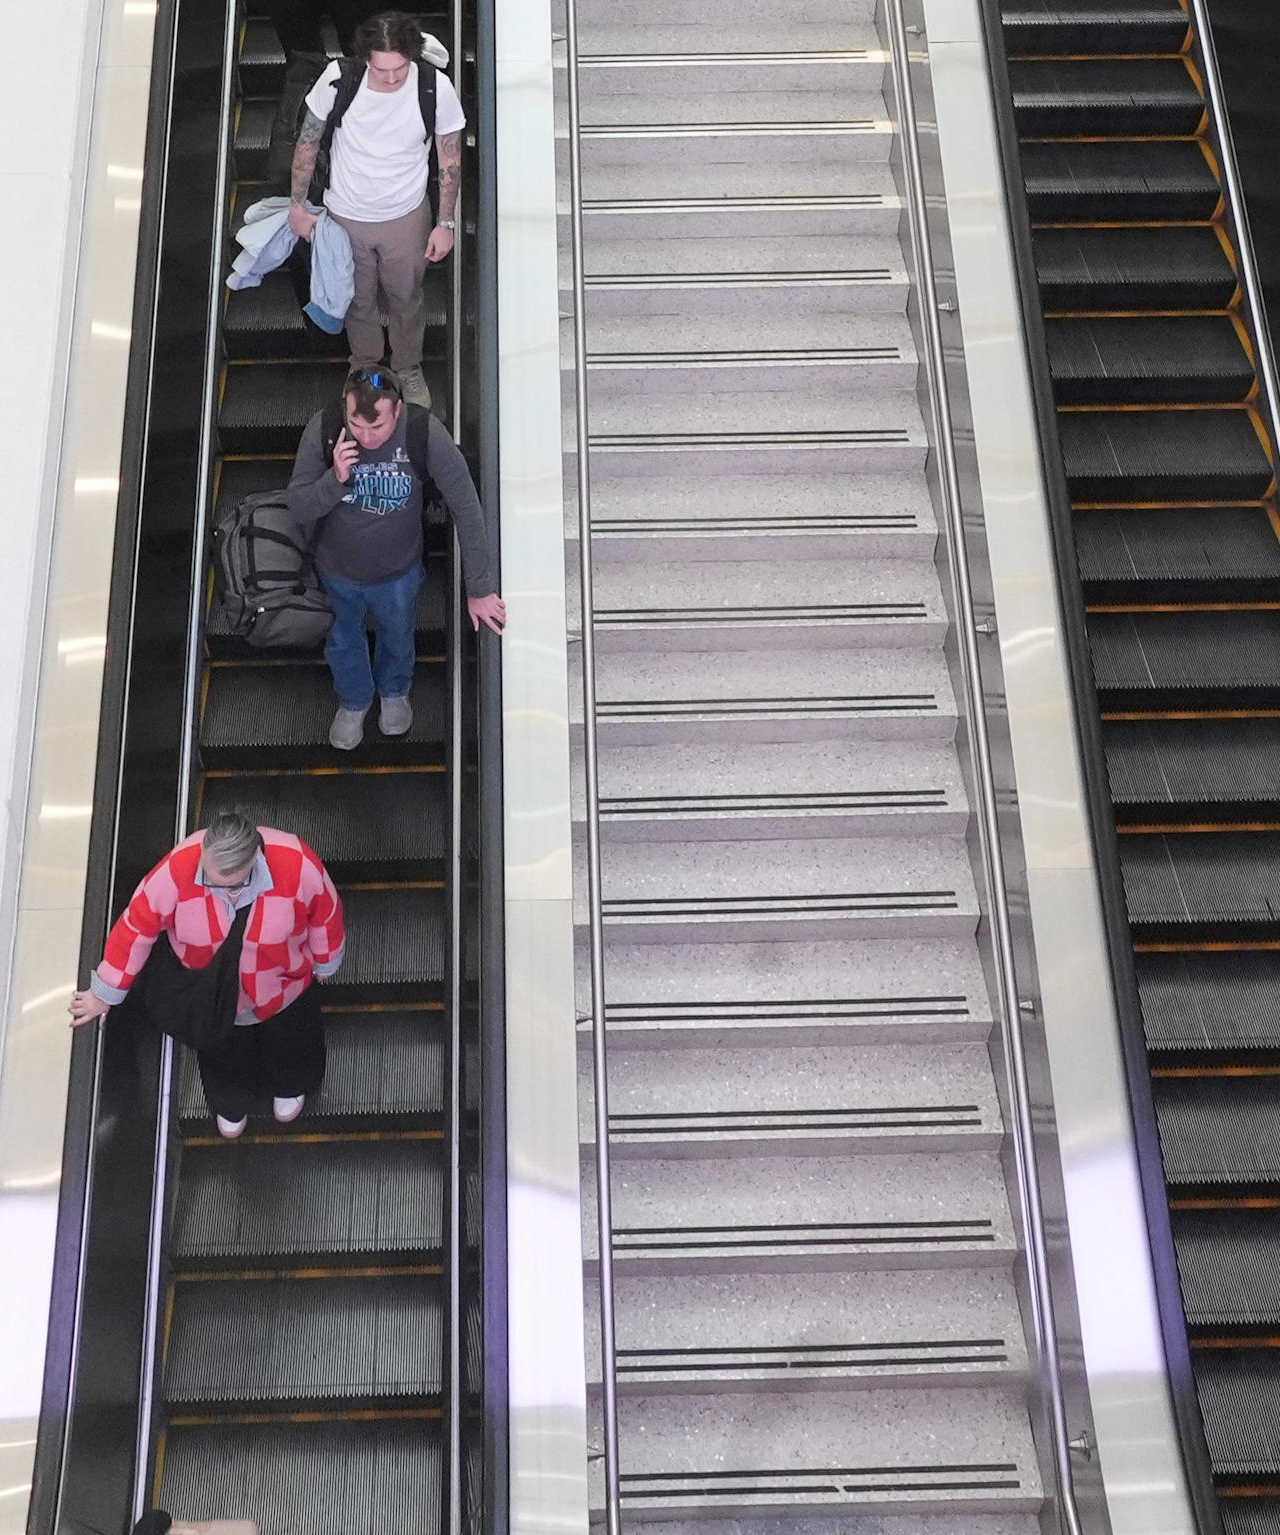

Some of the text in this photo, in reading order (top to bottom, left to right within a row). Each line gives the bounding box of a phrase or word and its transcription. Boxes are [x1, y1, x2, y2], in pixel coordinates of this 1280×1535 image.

[351, 462, 398, 474] AGLES
[354, 474, 412, 498] MPIONS
[361, 495, 409, 516] LIX
